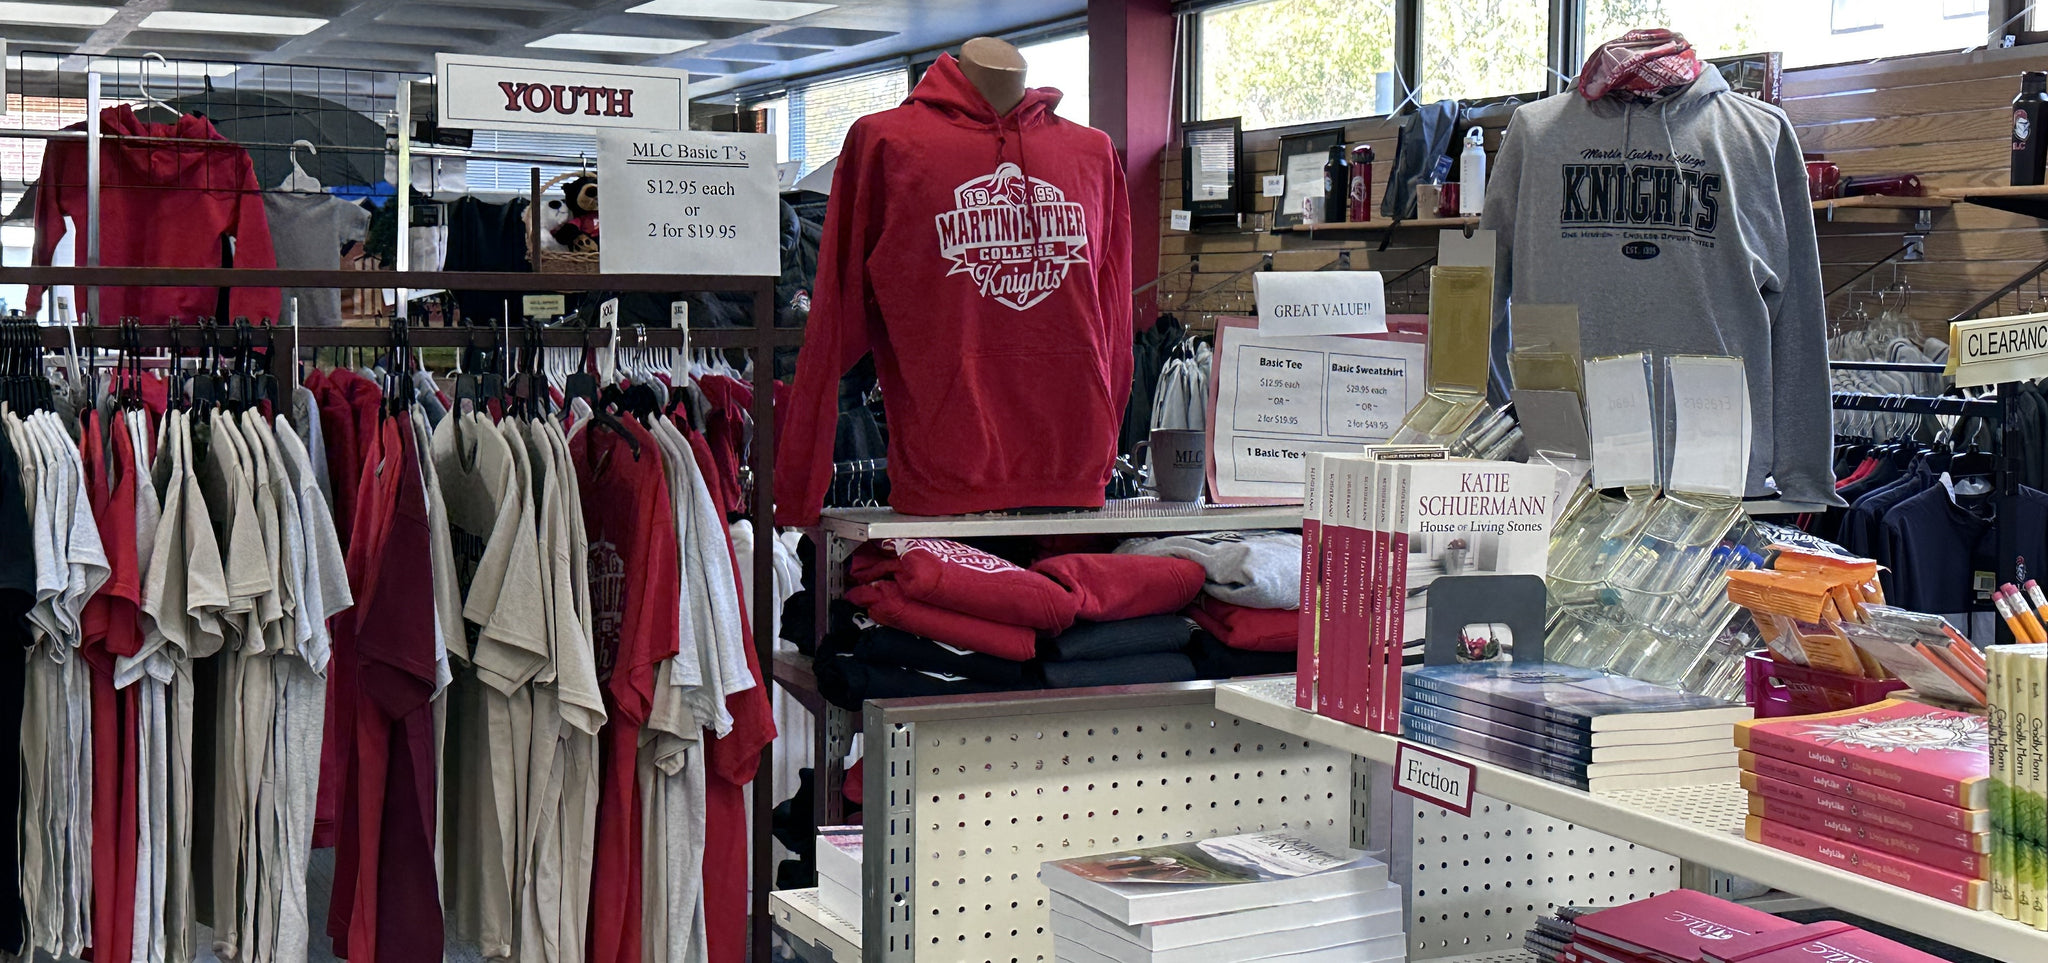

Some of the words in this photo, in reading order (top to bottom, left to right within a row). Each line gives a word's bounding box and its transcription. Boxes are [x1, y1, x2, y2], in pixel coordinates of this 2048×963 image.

[498, 81, 634, 118] YOUTH
[632, 142, 673, 158] MLC
[678, 144, 718, 160] Basic
[722, 146, 747, 161] T's
[647, 179, 697, 195] $12.95
[702, 181, 735, 196] each
[964, 189, 988, 206] 19
[1036, 187, 1055, 202] 95
[1560, 163, 1721, 233] KNIGHTS
[684, 205, 701, 217] or
[648, 223, 657, 237] 2
[662, 223, 683, 238] for
[687, 224, 737, 240] $19.95
[938, 206, 1012, 250] MARTIN
[1017, 204, 1086, 240] LUTHER
[975, 261, 1061, 305] Knights
[1274, 303, 1319, 318] GREAT
[1323, 302, 1371, 317] VALUE!!
[1968, 325, 2048, 357] CLEARANC
[1260, 357, 1283, 368] Basic
[1286, 359, 1303, 370] Tee
[1332, 363, 1354, 374] Basic
[1355, 364, 1404, 377] Sweatshirt
[1260, 378, 1283, 388] $12.95
[1284, 380, 1300, 389] each
[1346, 385, 1370, 395] $29.95
[1371, 387, 1387, 396] each
[1273, 397, 1284, 406] OR
[1361, 402, 1372, 411] OR
[1257, 414, 1263, 422] 2
[1263, 414, 1274, 423] for
[1274, 415, 1298, 425] $19.95
[1347, 419, 1352, 428] 2
[1353, 420, 1363, 428] for
[1175, 449, 1203, 464] MLC
[1247, 447, 1252, 457] 1
[1254, 447, 1280, 458] Basic
[1281, 449, 1299, 459] Tee
[1460, 472, 1510, 493] KATIE
[1418, 495, 1546, 517] SCHUERMANN
[1420, 520, 1455, 533] House
[1470, 520, 1505, 536] Living
[1507, 520, 1543, 532] Stones
[1305, 544, 1313, 569] Choir
[1325, 550, 1333, 576] Choir
[1303, 571, 1312, 615] Immortal
[1324, 576, 1332, 621] Immortal
[1375, 584, 1383, 615] Living
[1393, 585, 1401, 616] Living
[1374, 616, 1382, 646] Stones
[1392, 616, 1400, 648] Stones
[2015, 712, 2026, 746] Godly
[2032, 717, 2043, 752] Godly
[1808, 751, 1835, 765] LadyLike
[1406, 758, 1459, 797] Fiction
[1813, 776, 1840, 789] LadyLike
[1817, 797, 1845, 811] LadyLike
[1824, 819, 1852, 833] LadyLike
[1818, 845, 1846, 860] LadyLike
